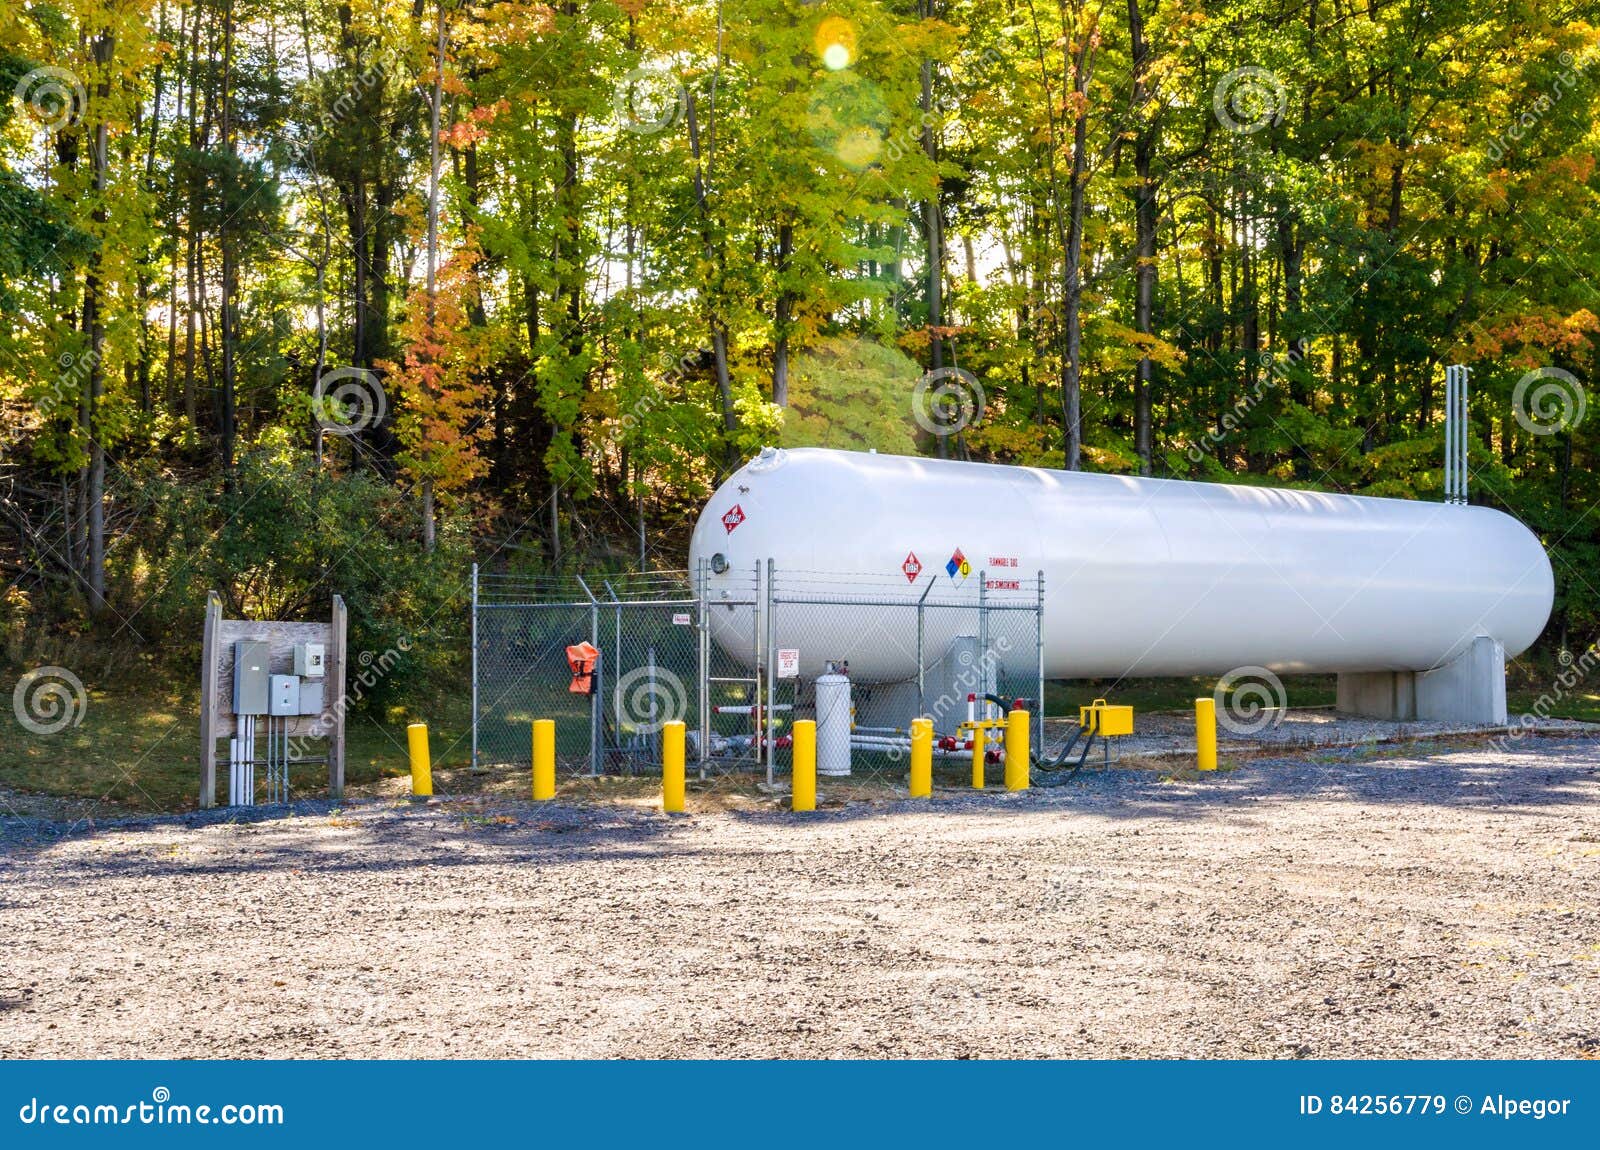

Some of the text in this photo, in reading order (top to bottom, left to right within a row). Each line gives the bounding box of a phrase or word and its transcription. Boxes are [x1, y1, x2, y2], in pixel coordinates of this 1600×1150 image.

[962, 561, 969, 576] 0
[986, 580, 1021, 591] NO SMOKING
